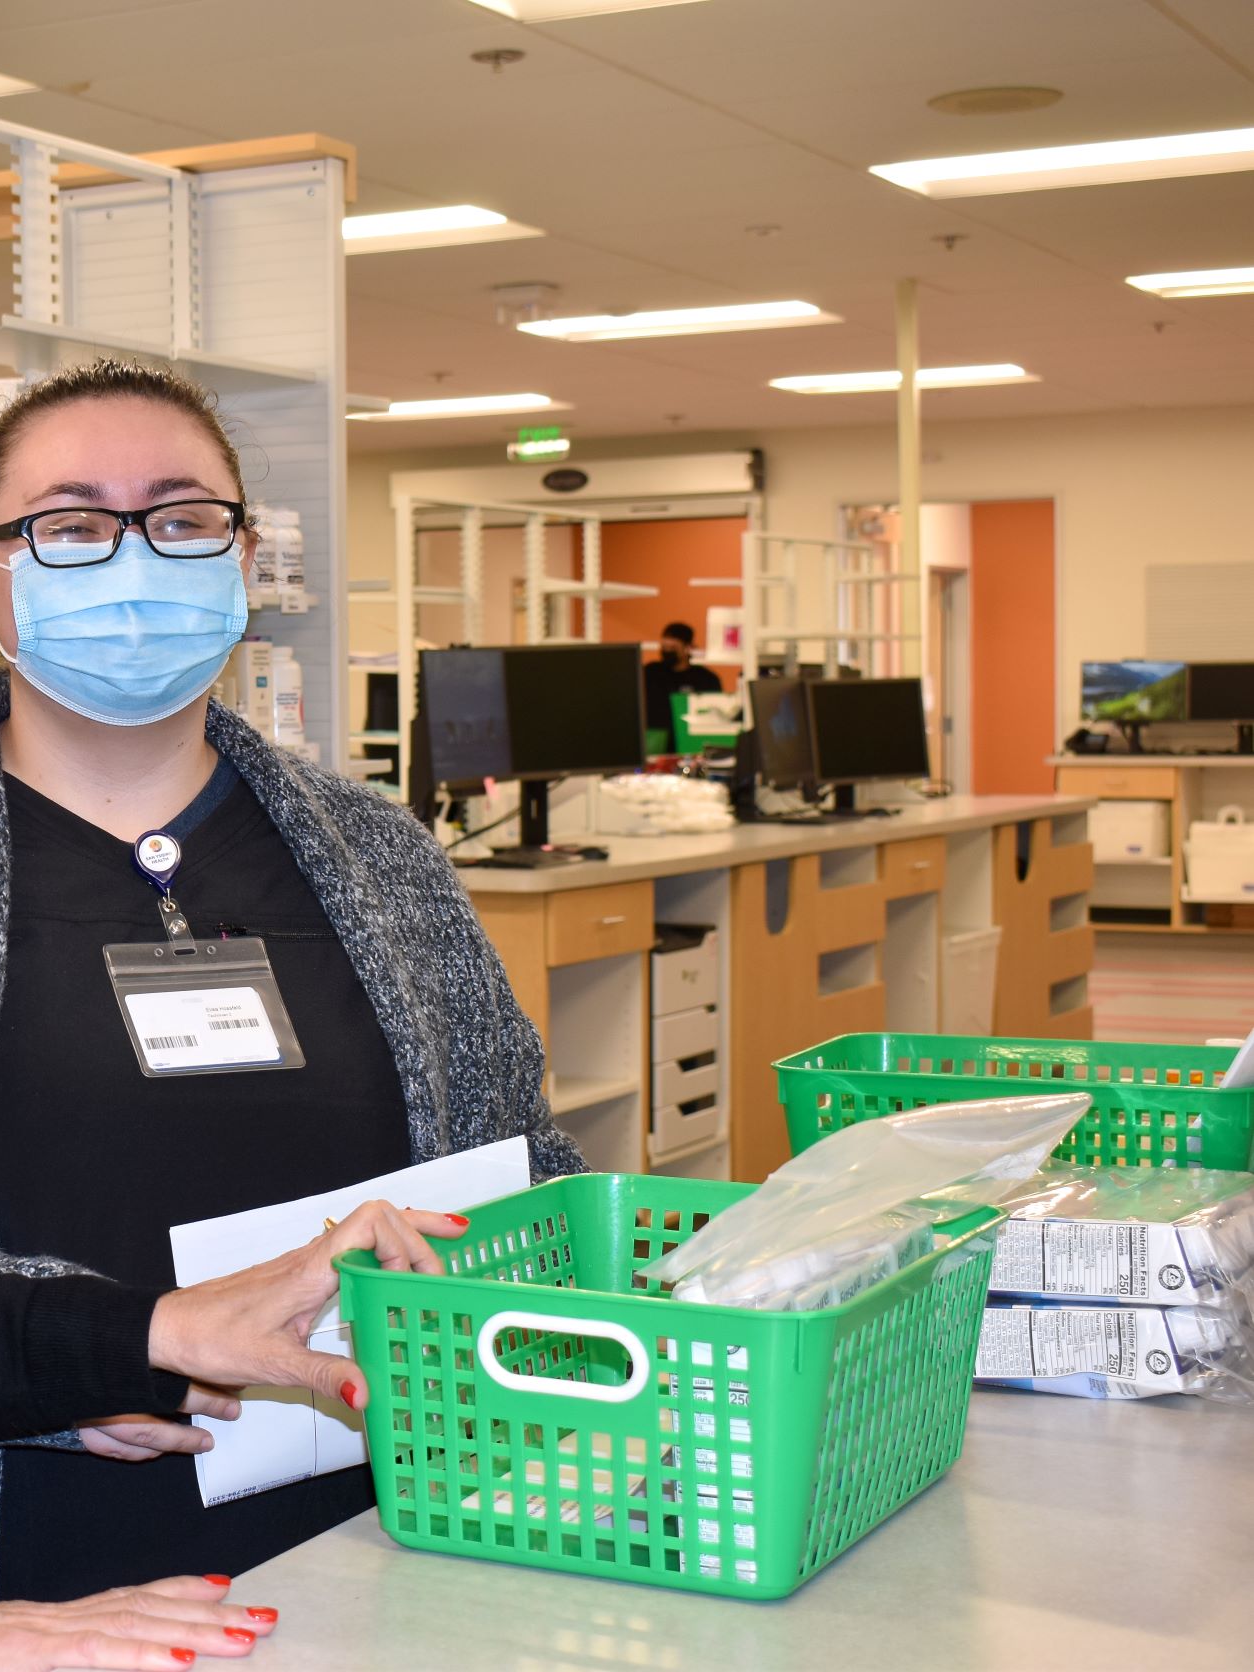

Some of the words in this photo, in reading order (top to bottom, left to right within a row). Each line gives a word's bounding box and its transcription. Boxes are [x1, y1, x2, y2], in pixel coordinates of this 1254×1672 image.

[1118, 1227, 1126, 1256] Calories
[1119, 1274, 1129, 1295] 250
[1128, 1313, 1136, 1349] Nutrition
[1109, 1354, 1119, 1374] 250
[1128, 1352, 1136, 1377] Facts
